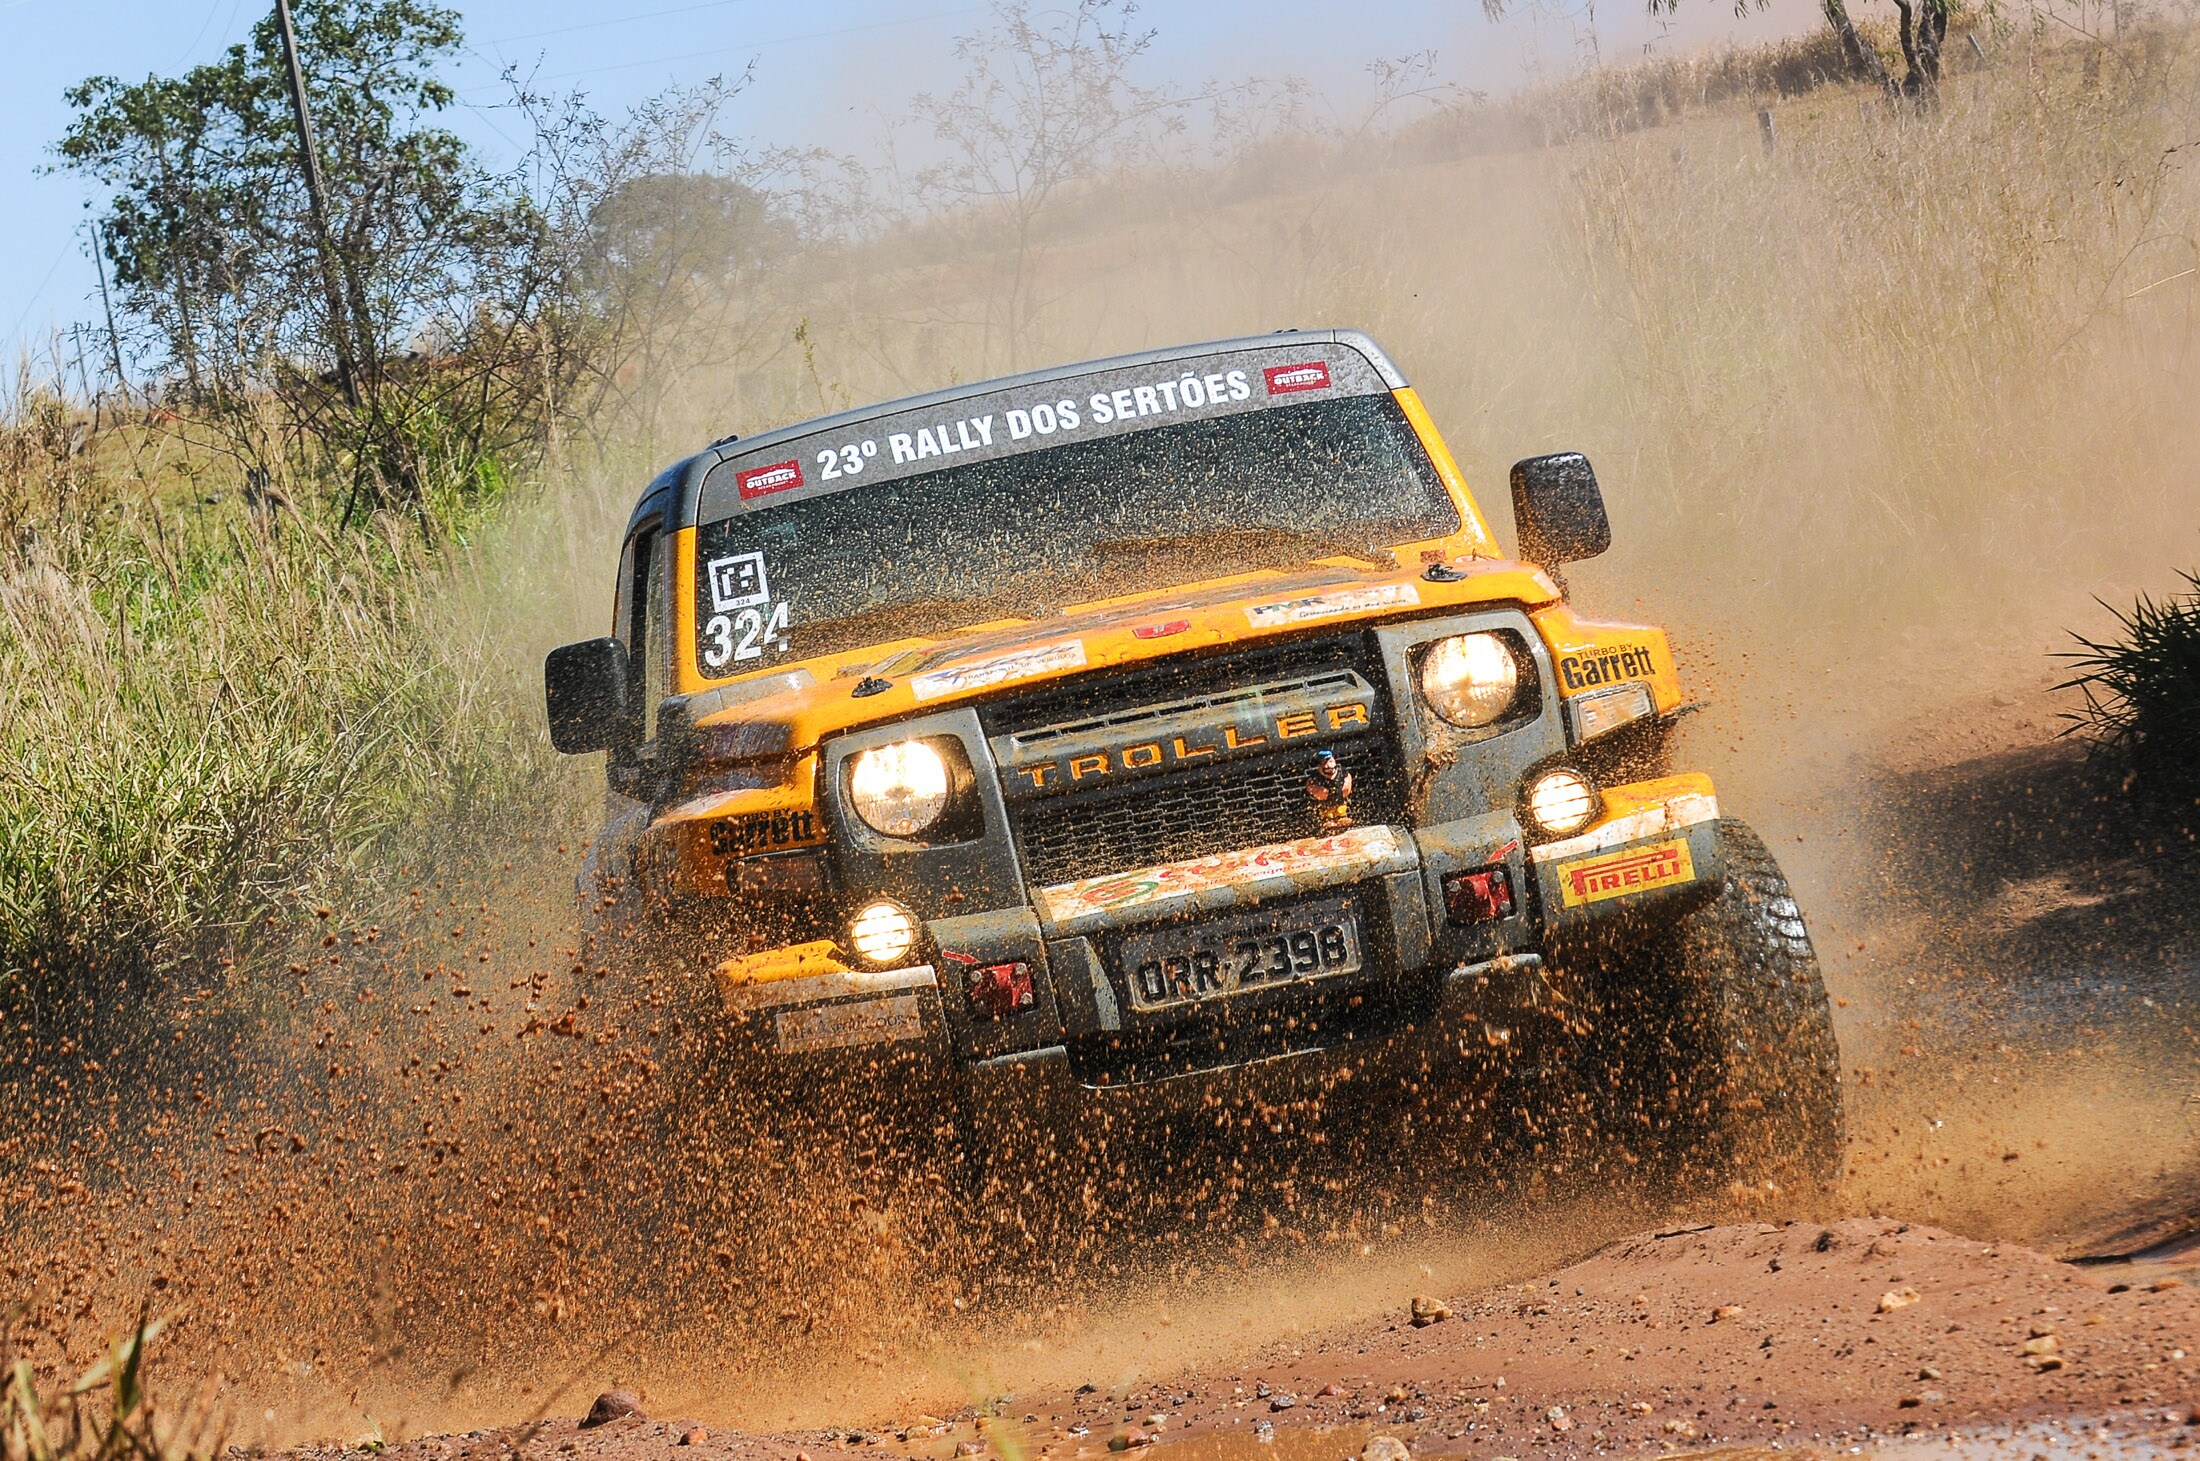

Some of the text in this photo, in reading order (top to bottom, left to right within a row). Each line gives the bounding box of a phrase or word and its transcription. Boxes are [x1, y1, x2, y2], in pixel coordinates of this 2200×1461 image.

[1274, 372, 1325, 385] OUTBACK
[888, 414, 994, 465] RALLY
[1005, 399, 1081, 442] DOS
[1089, 370, 1251, 424] SERTÕES
[746, 471, 797, 489] OUTBACK
[736, 598, 751, 606] 324
[704, 601, 789, 667] 324
[1576, 643, 1633, 660] TURBO BY
[1560, 645, 1656, 690] Garrett
[1016, 702, 1371, 788] TROLLER
[710, 809, 816, 856] Garrett
[773, 808, 790, 817] BY
[1570, 848, 1681, 897] PIRELLI
